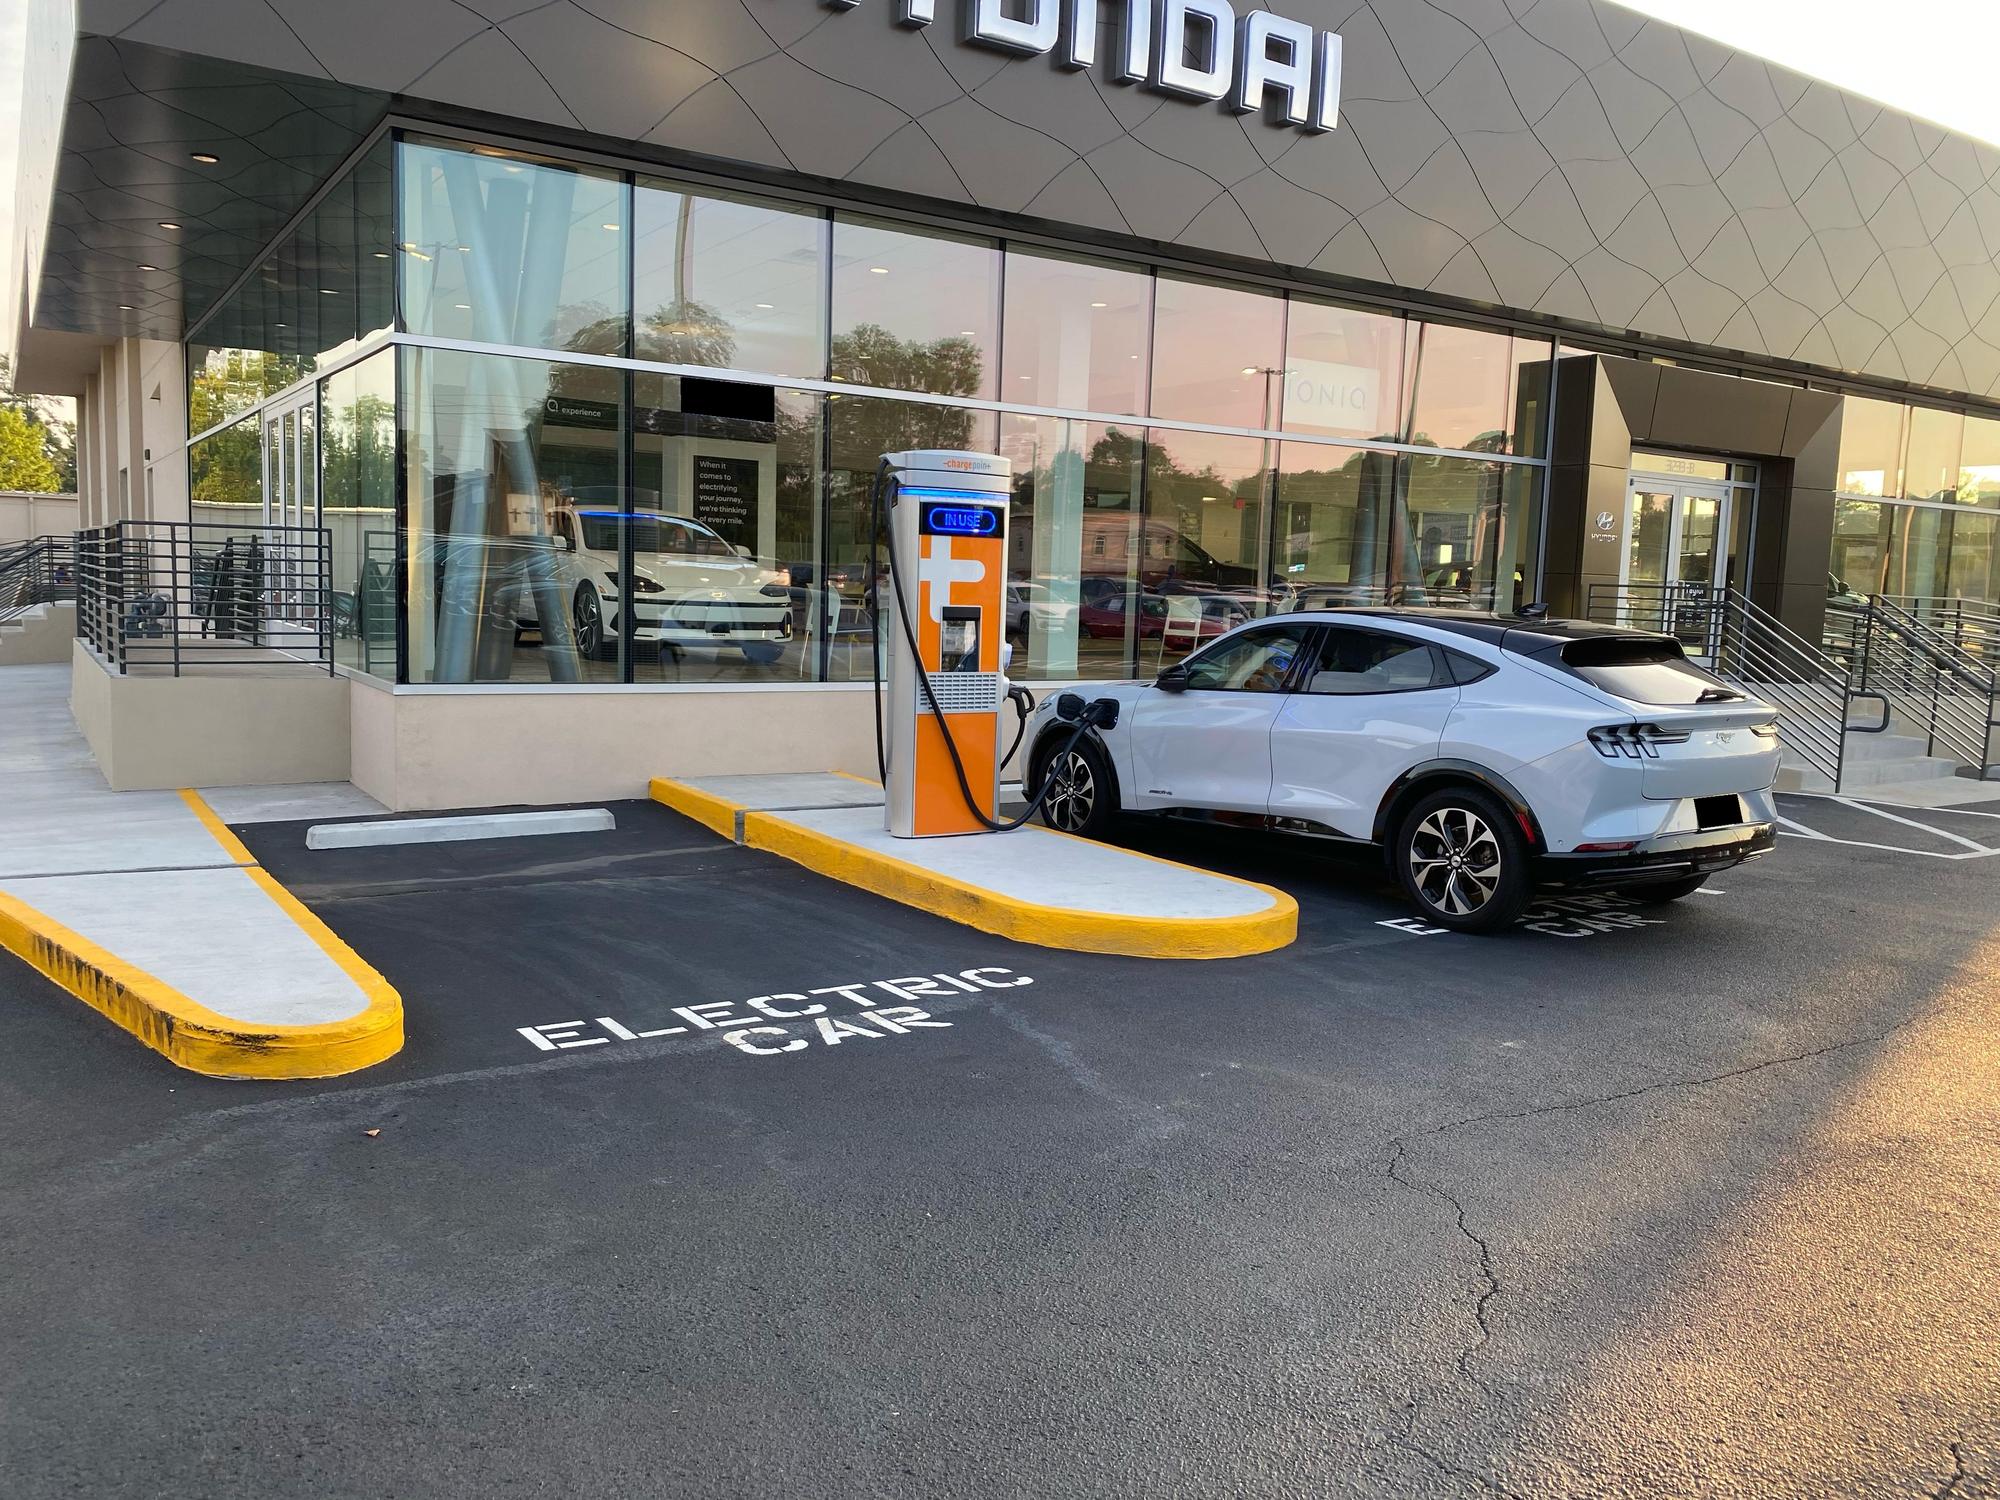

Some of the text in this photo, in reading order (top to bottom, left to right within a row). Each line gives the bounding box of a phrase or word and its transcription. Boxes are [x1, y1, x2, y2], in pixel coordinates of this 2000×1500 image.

[1286, 377, 1366, 411] IONIQ
[561, 407, 602, 418] experience
[699, 461, 727, 470] When it
[699, 483, 738, 493] electrifying
[699, 494, 743, 504] your journey,
[719, 505, 747, 515] thinking
[944, 513, 981, 527] IN USE
[1524, 911, 1668, 937] CAR
[516, 967, 1034, 1051] ELECTRIC
[722, 1005, 955, 1056] CAR
